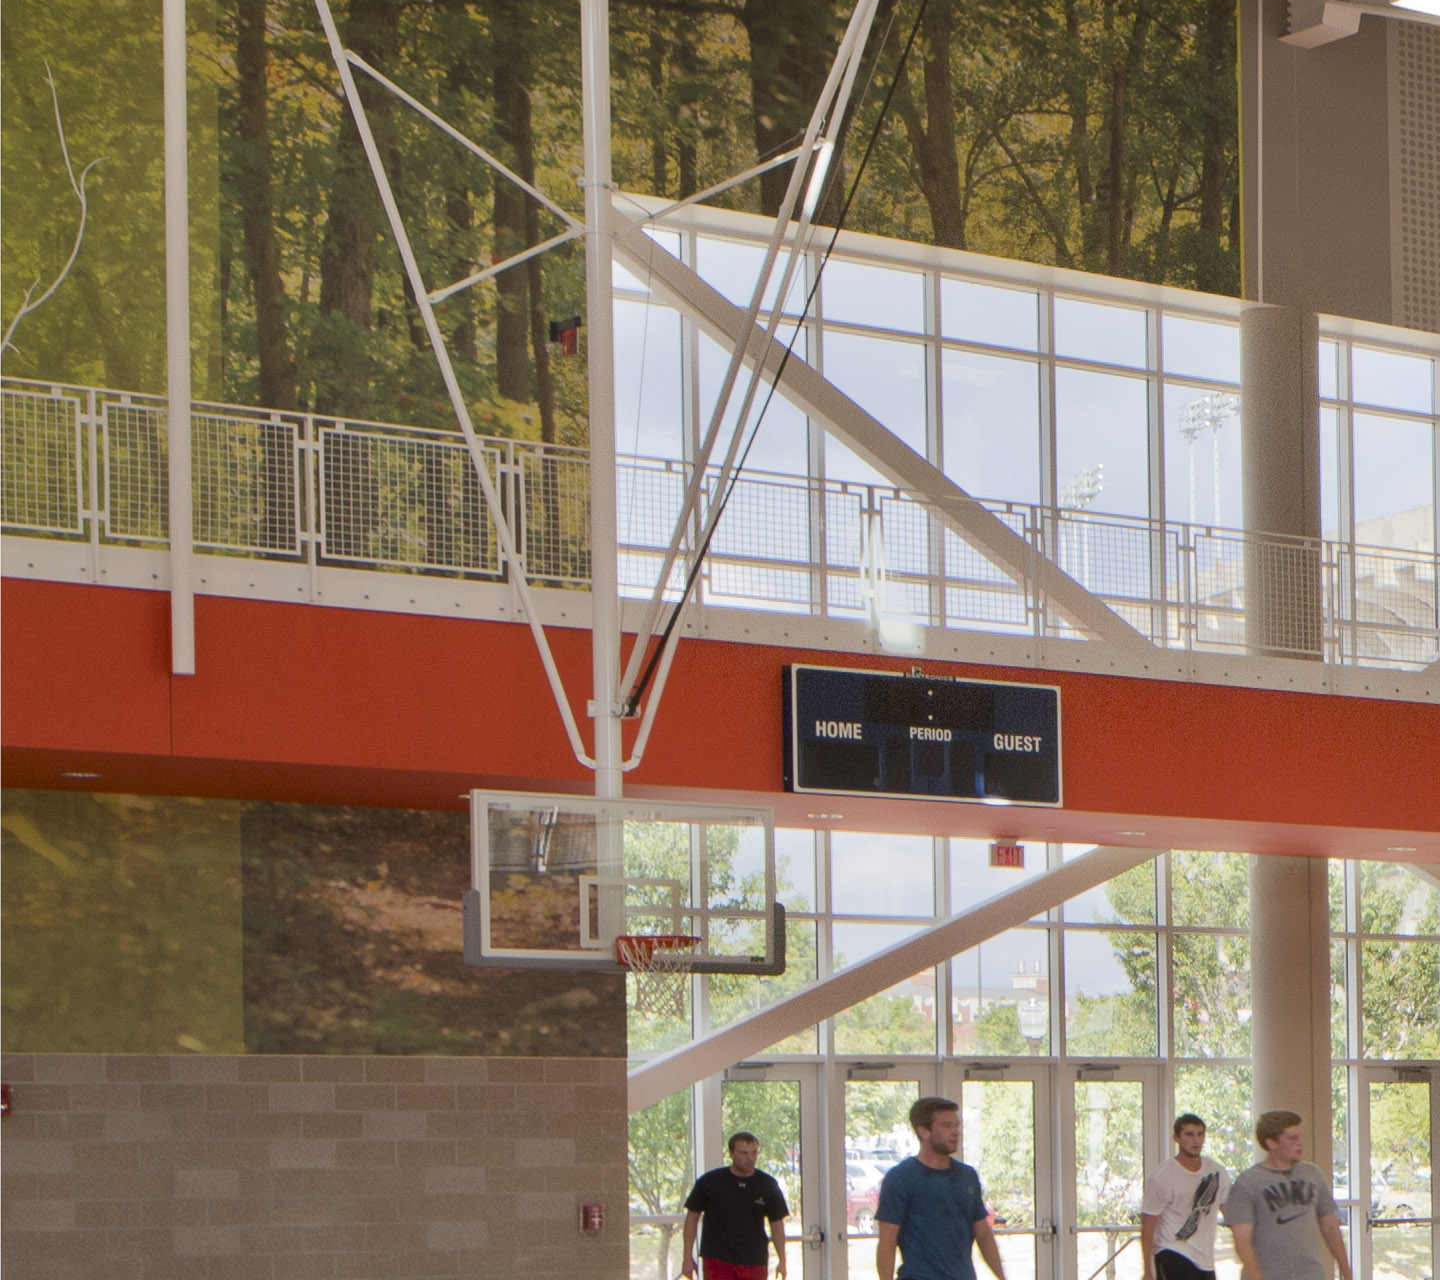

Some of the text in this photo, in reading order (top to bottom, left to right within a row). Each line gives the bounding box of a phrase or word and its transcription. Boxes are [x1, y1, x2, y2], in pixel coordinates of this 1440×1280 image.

[815, 720, 1042, 753] HOME PERIOD GUEST
[996, 846, 1020, 865] EXIT
[1264, 1179, 1314, 1212] NIKE
